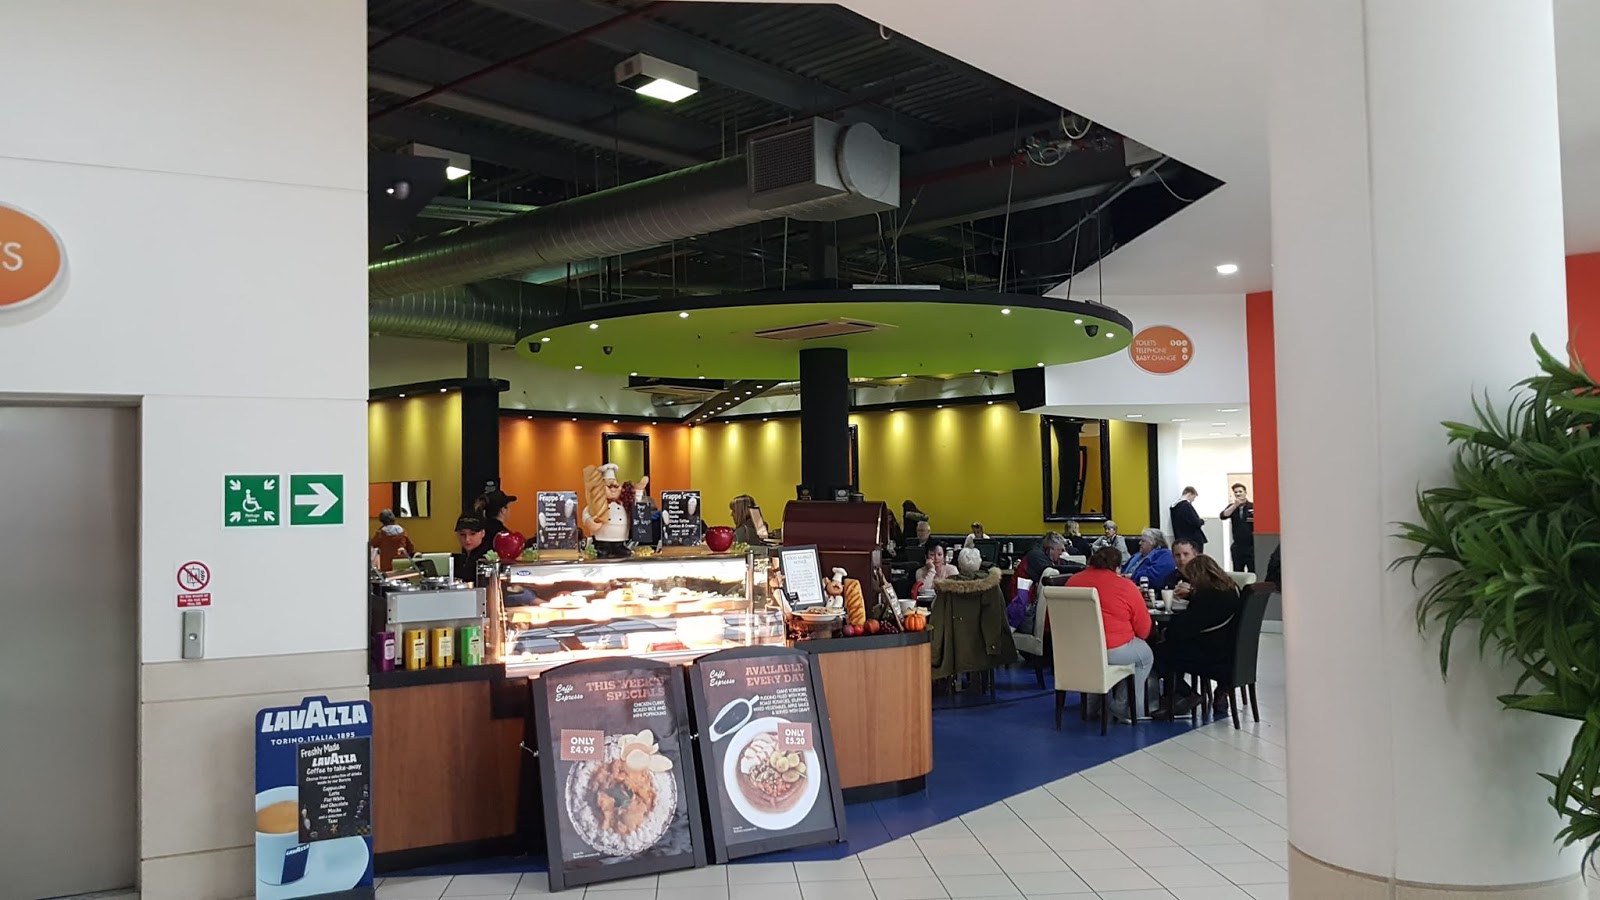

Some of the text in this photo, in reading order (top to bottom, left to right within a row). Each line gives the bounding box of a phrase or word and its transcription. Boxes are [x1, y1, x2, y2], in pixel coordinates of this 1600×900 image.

[0, 242, 23, 272] S
[745, 663, 804, 676] AVAILABLE
[586, 680, 616, 692] THIS
[710, 678, 735, 687] Espresso
[747, 673, 804, 687] EVERY DAY
[555, 693, 583, 702] Espresso
[607, 687, 665, 701] SPECIALS
[261, 700, 368, 733] LAVAZZA
[570, 736, 595, 745] ONLY
[301, 743, 340, 758] Freshly Made
[570, 745, 594, 754] £4.99
[312, 753, 357, 767] LAVAZZA
